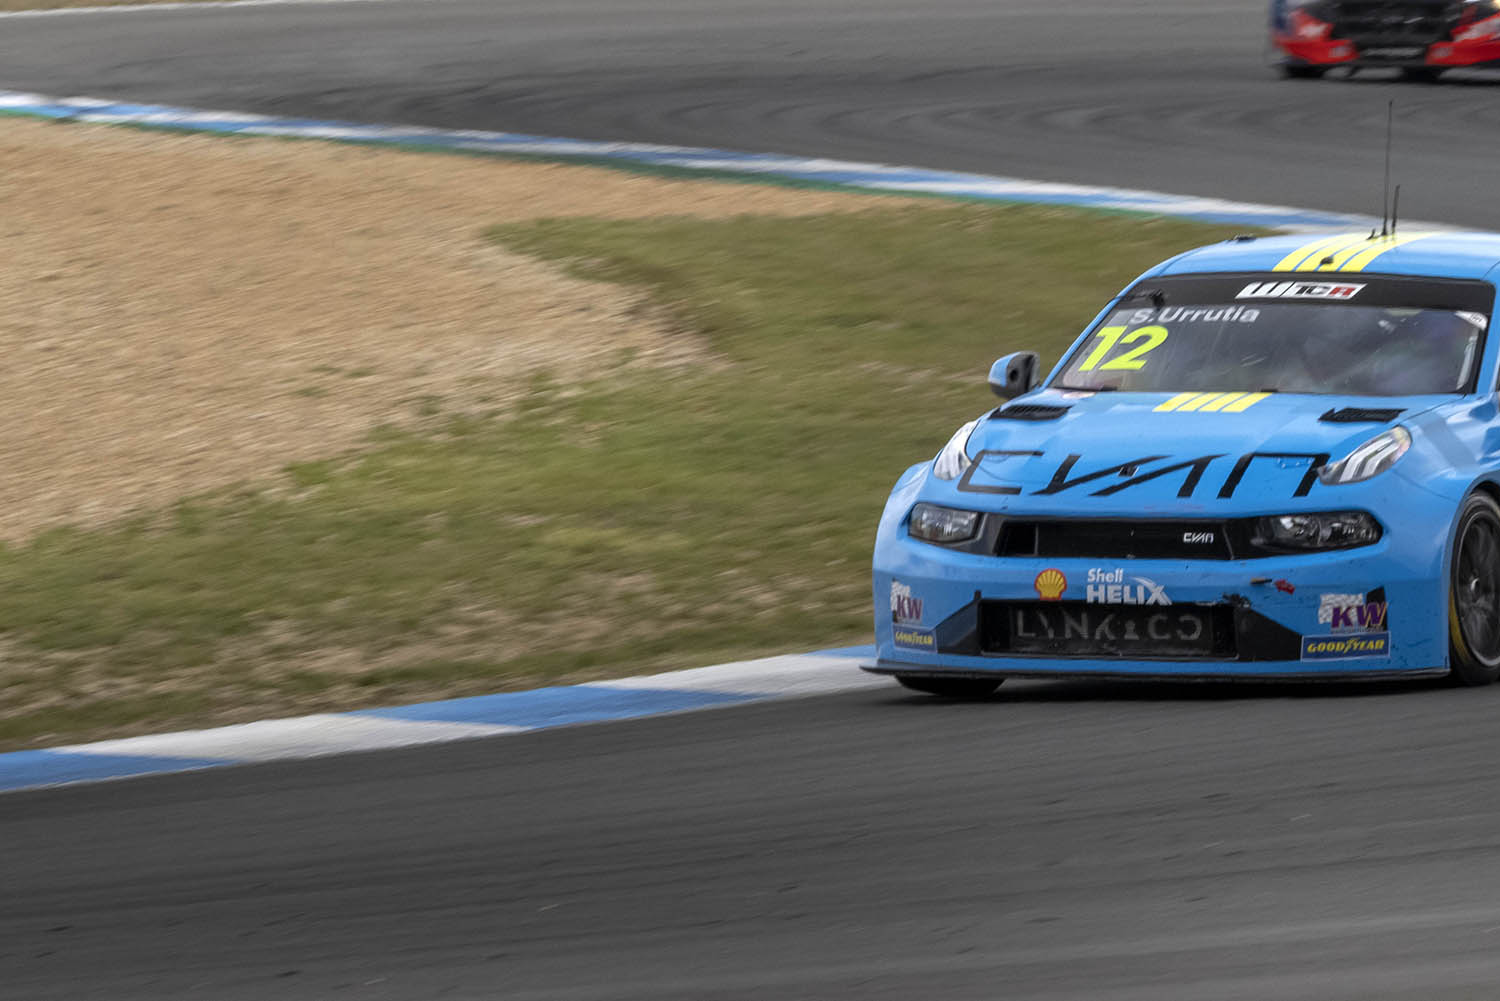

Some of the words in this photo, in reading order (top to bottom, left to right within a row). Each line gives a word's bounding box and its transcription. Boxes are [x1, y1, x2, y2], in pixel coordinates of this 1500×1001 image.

[1078, 325, 1169, 371] 12
[1087, 568, 1124, 583] Shell
[1086, 584, 1172, 605] HELIX
[1331, 603, 1387, 628] KW
[1307, 638, 1385, 653] GOODYEAR
